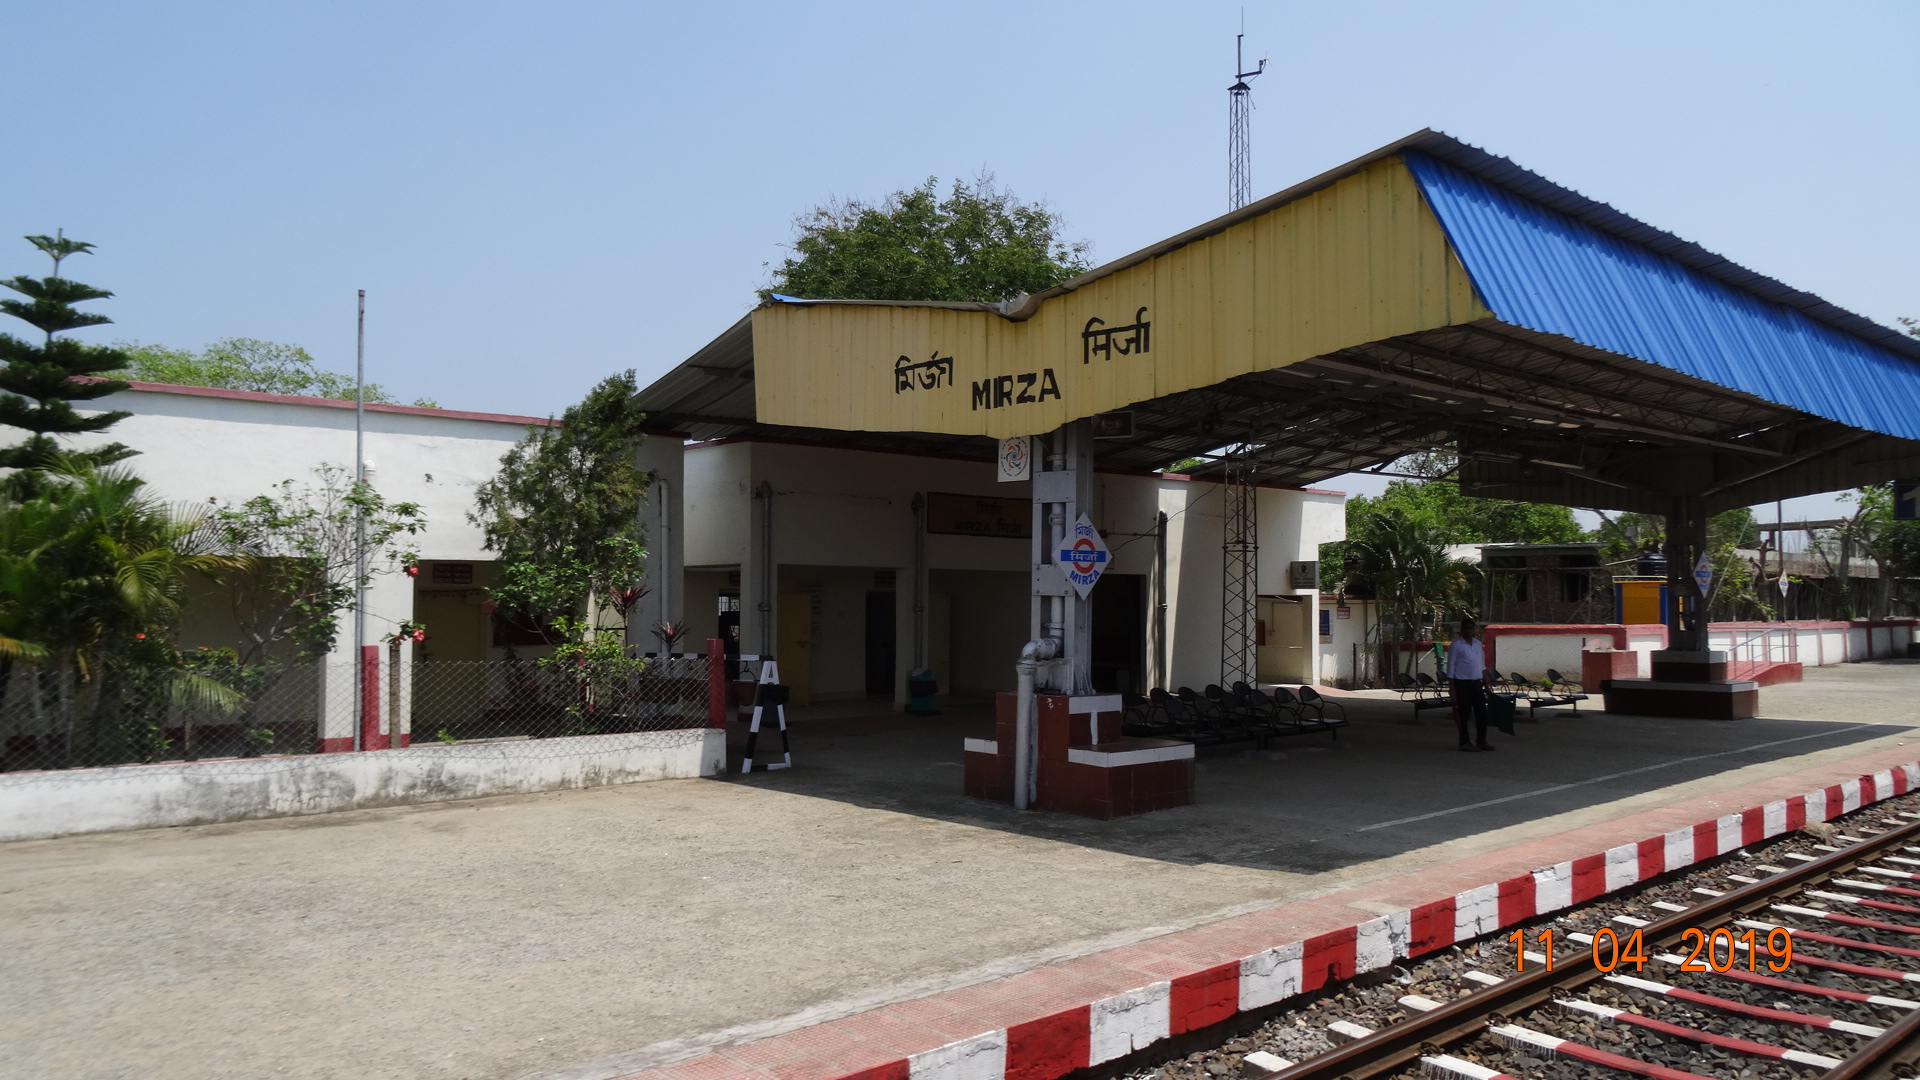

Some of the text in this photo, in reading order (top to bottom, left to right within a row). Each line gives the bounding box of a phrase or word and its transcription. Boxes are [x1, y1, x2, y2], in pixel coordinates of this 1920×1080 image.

[1081, 306, 1150, 364] मिर्जा
[972, 368, 1061, 411] MIRZA
[954, 520, 992, 533] MIRZA
[1069, 550, 1098, 562] मिर्जा
[1069, 569, 1100, 585] MIRZA
